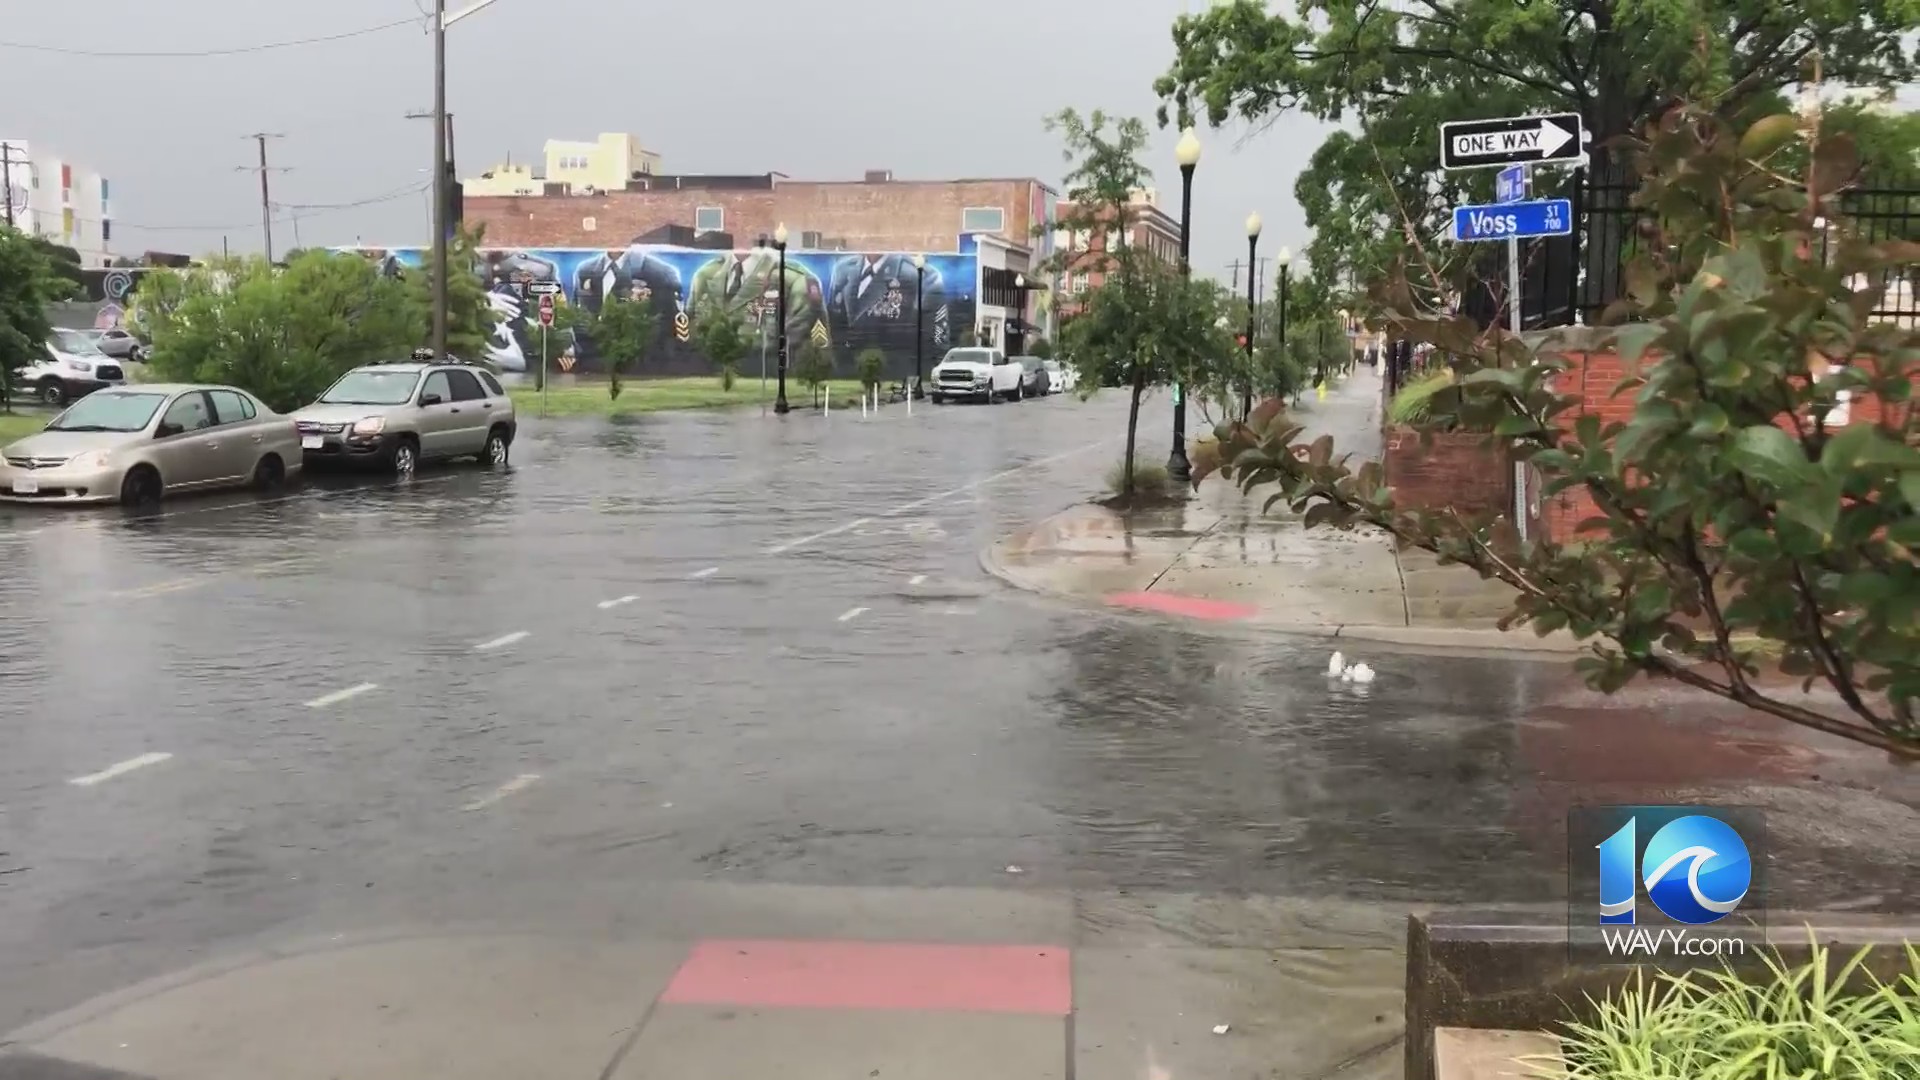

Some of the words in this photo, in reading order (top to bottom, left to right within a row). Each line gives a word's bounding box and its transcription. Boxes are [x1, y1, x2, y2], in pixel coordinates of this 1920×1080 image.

[1458, 135, 1494, 153] ONE
[1502, 131, 1541, 149] WAY
[1469, 211, 1517, 235] Voss
[1546, 205, 1559, 217] ST
[1544, 218, 1561, 231] 700
